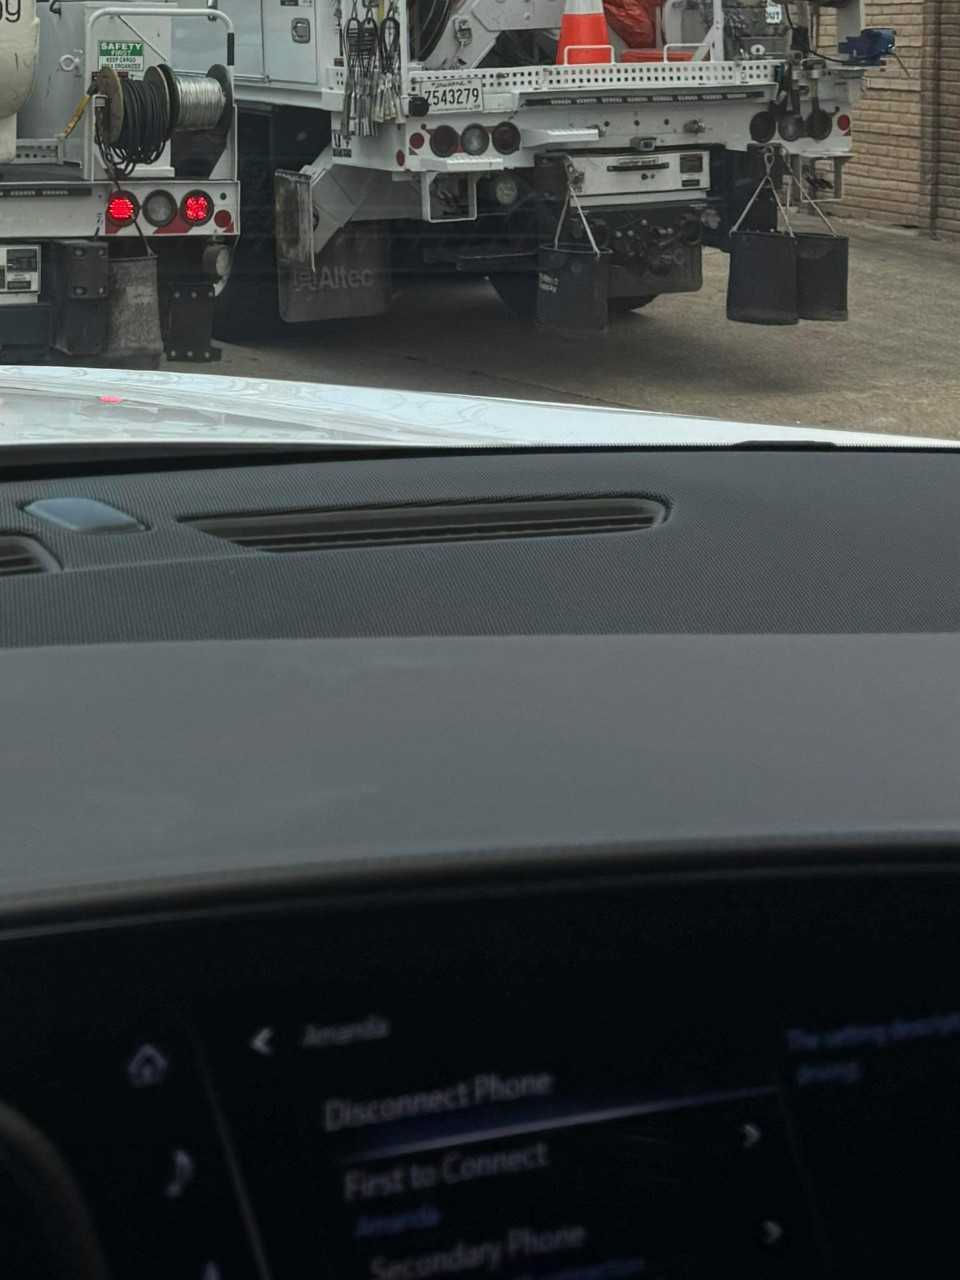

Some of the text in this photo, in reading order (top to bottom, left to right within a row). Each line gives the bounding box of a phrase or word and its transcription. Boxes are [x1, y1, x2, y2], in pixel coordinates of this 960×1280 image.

[101, 42, 142, 50] SAFETY
[324, 1072, 554, 1132] Disconnect Phone
[344, 1142, 548, 1201] First to Connect
[369, 1239, 502, 1280] Secondary
[506, 1225, 588, 1258] Phone
